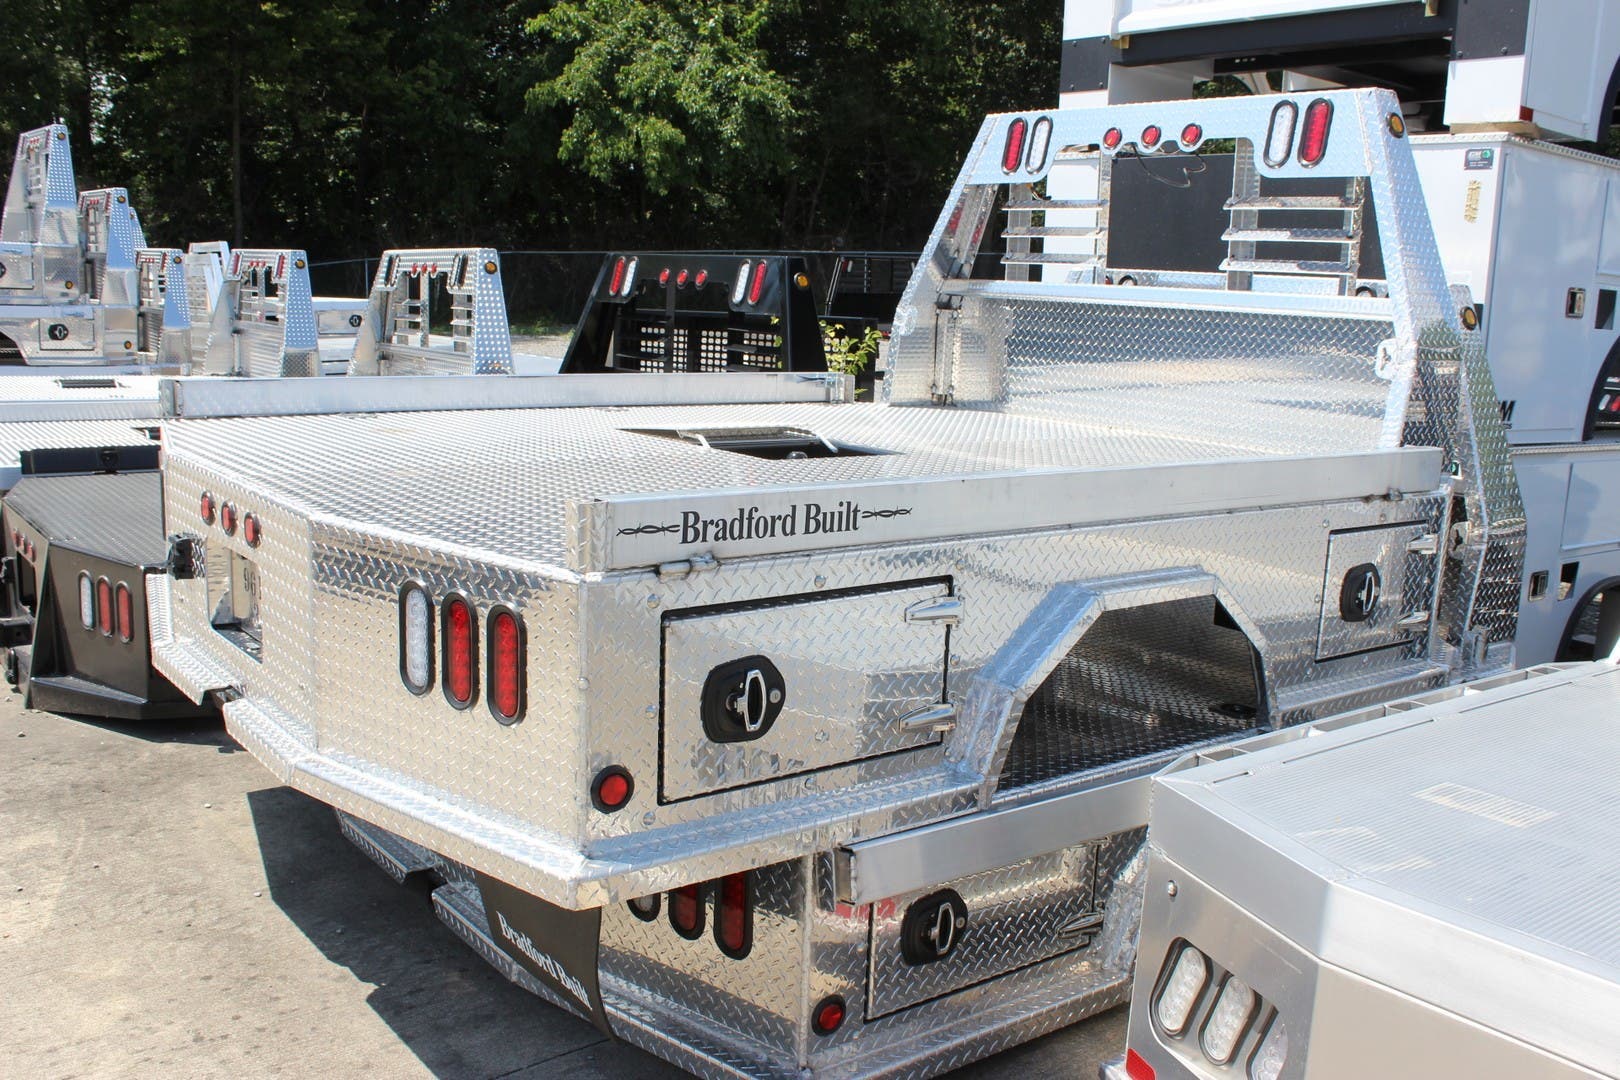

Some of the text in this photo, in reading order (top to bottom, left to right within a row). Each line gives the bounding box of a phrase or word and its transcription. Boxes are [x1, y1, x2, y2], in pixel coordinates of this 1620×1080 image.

[679, 501, 861, 544] Bradford Built
[496, 911, 593, 1011] Bradford Built
